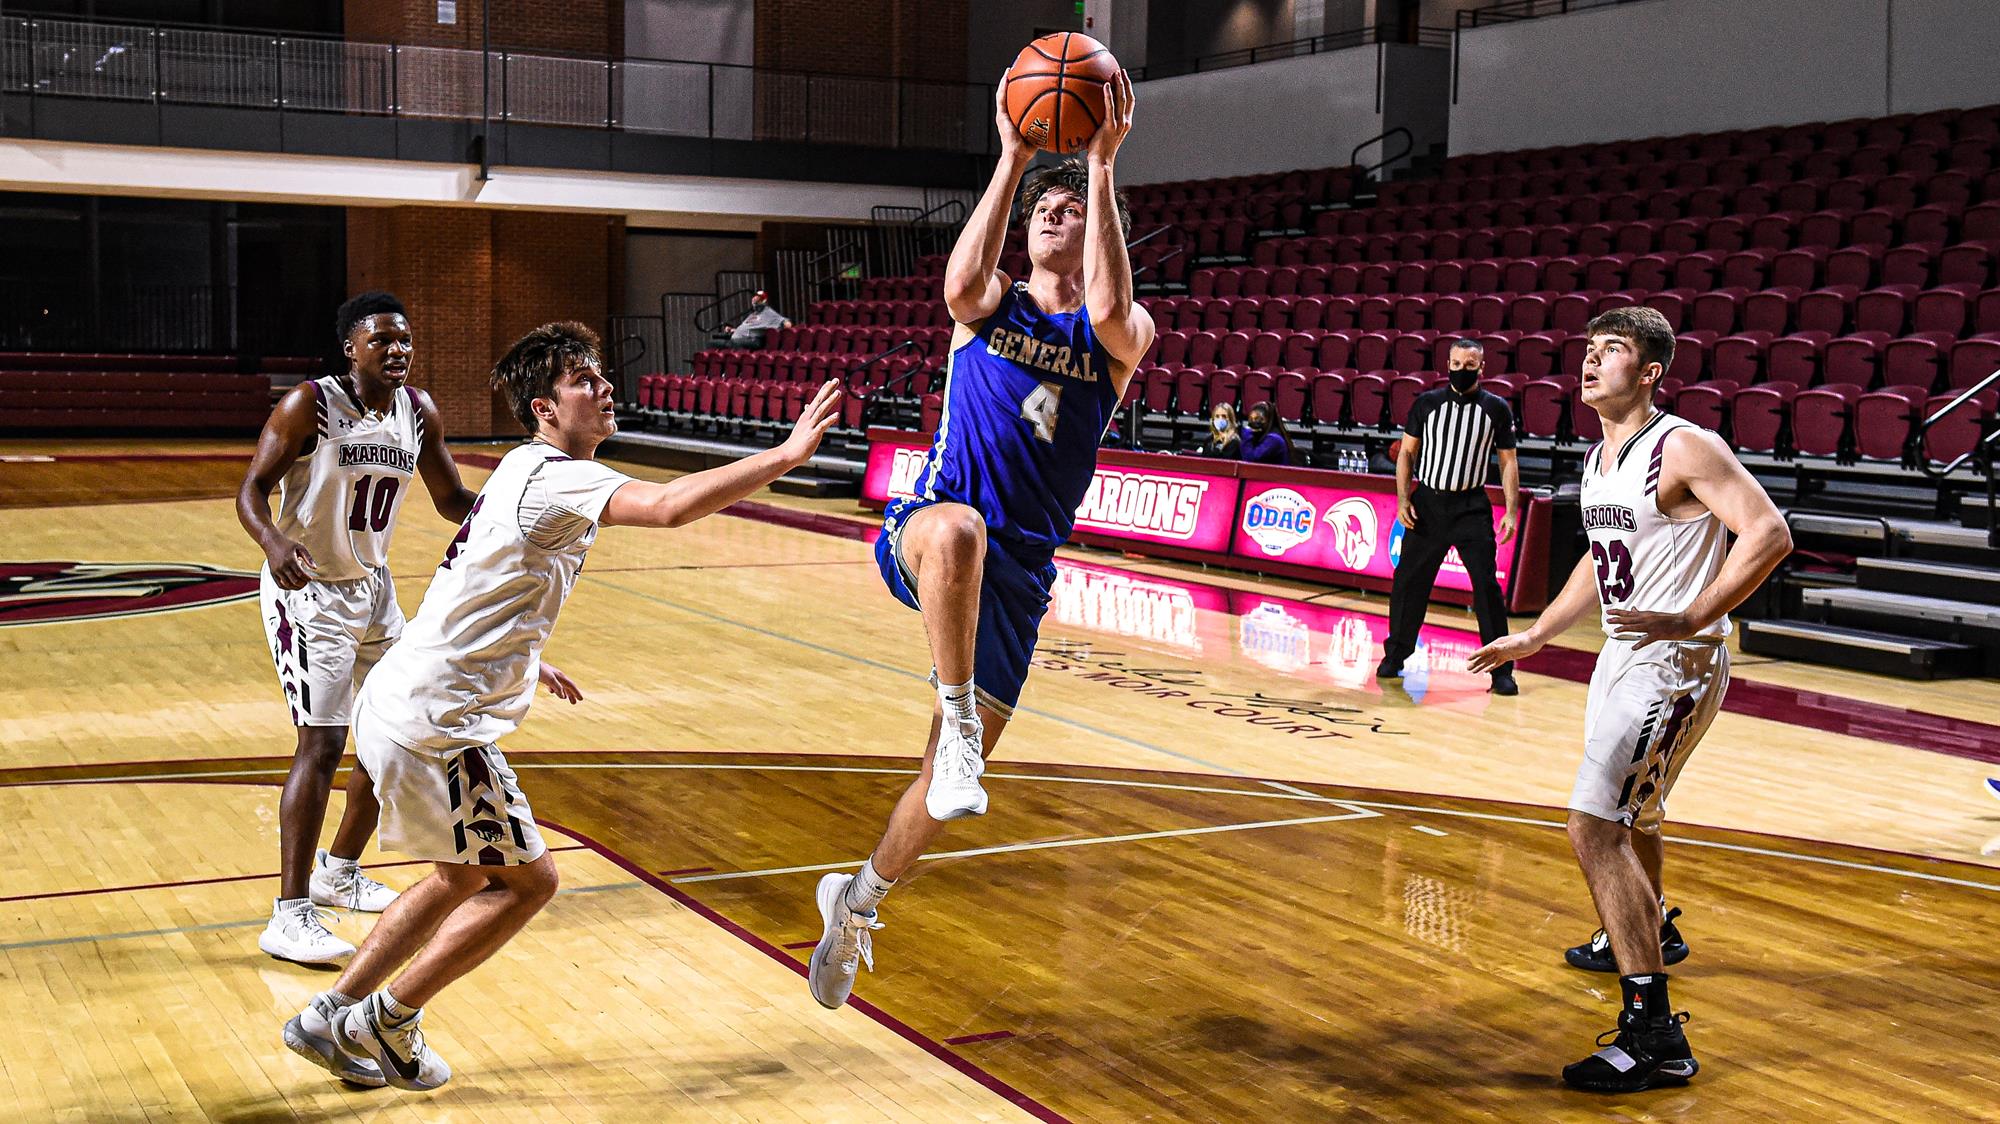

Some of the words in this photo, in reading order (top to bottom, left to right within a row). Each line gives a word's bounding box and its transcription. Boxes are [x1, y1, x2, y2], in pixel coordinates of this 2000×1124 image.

[986, 327, 1098, 382] GENERAL
[1020, 381, 1064, 444] 4
[339, 443, 415, 474] MAROONS
[348, 474, 400, 532] 10
[1075, 471, 1205, 538] AROONS
[1247, 502, 1311, 533] ODAC
[1582, 504, 1637, 532] AROONS
[1591, 539, 1635, 605] 23
[1074, 672, 1191, 698] MOIR
[1186, 700, 1353, 739] COURT
